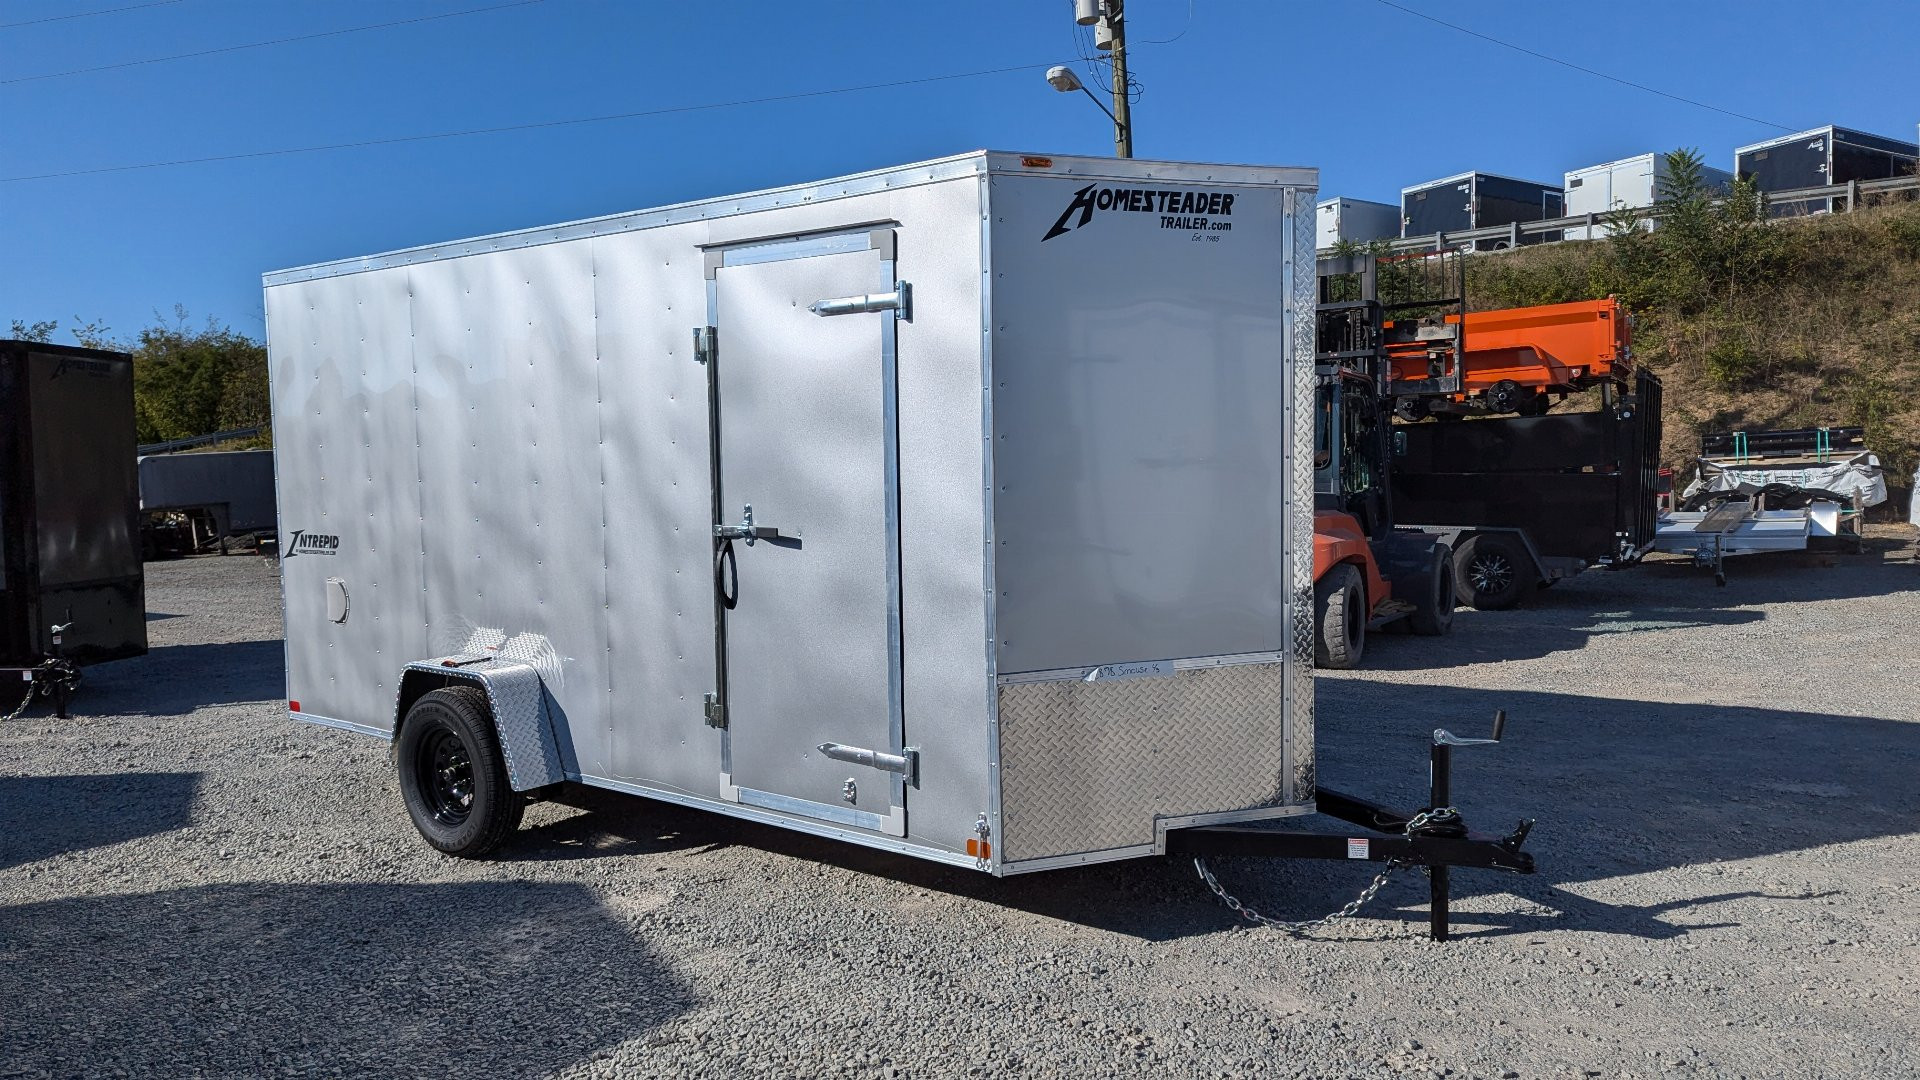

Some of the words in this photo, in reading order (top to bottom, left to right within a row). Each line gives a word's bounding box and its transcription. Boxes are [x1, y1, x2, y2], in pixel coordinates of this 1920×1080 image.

[1041, 183, 1235, 242] HOMESTEADER
[1160, 216, 1232, 231] TRAILER.com
[284, 529, 339, 558] INTREPID
